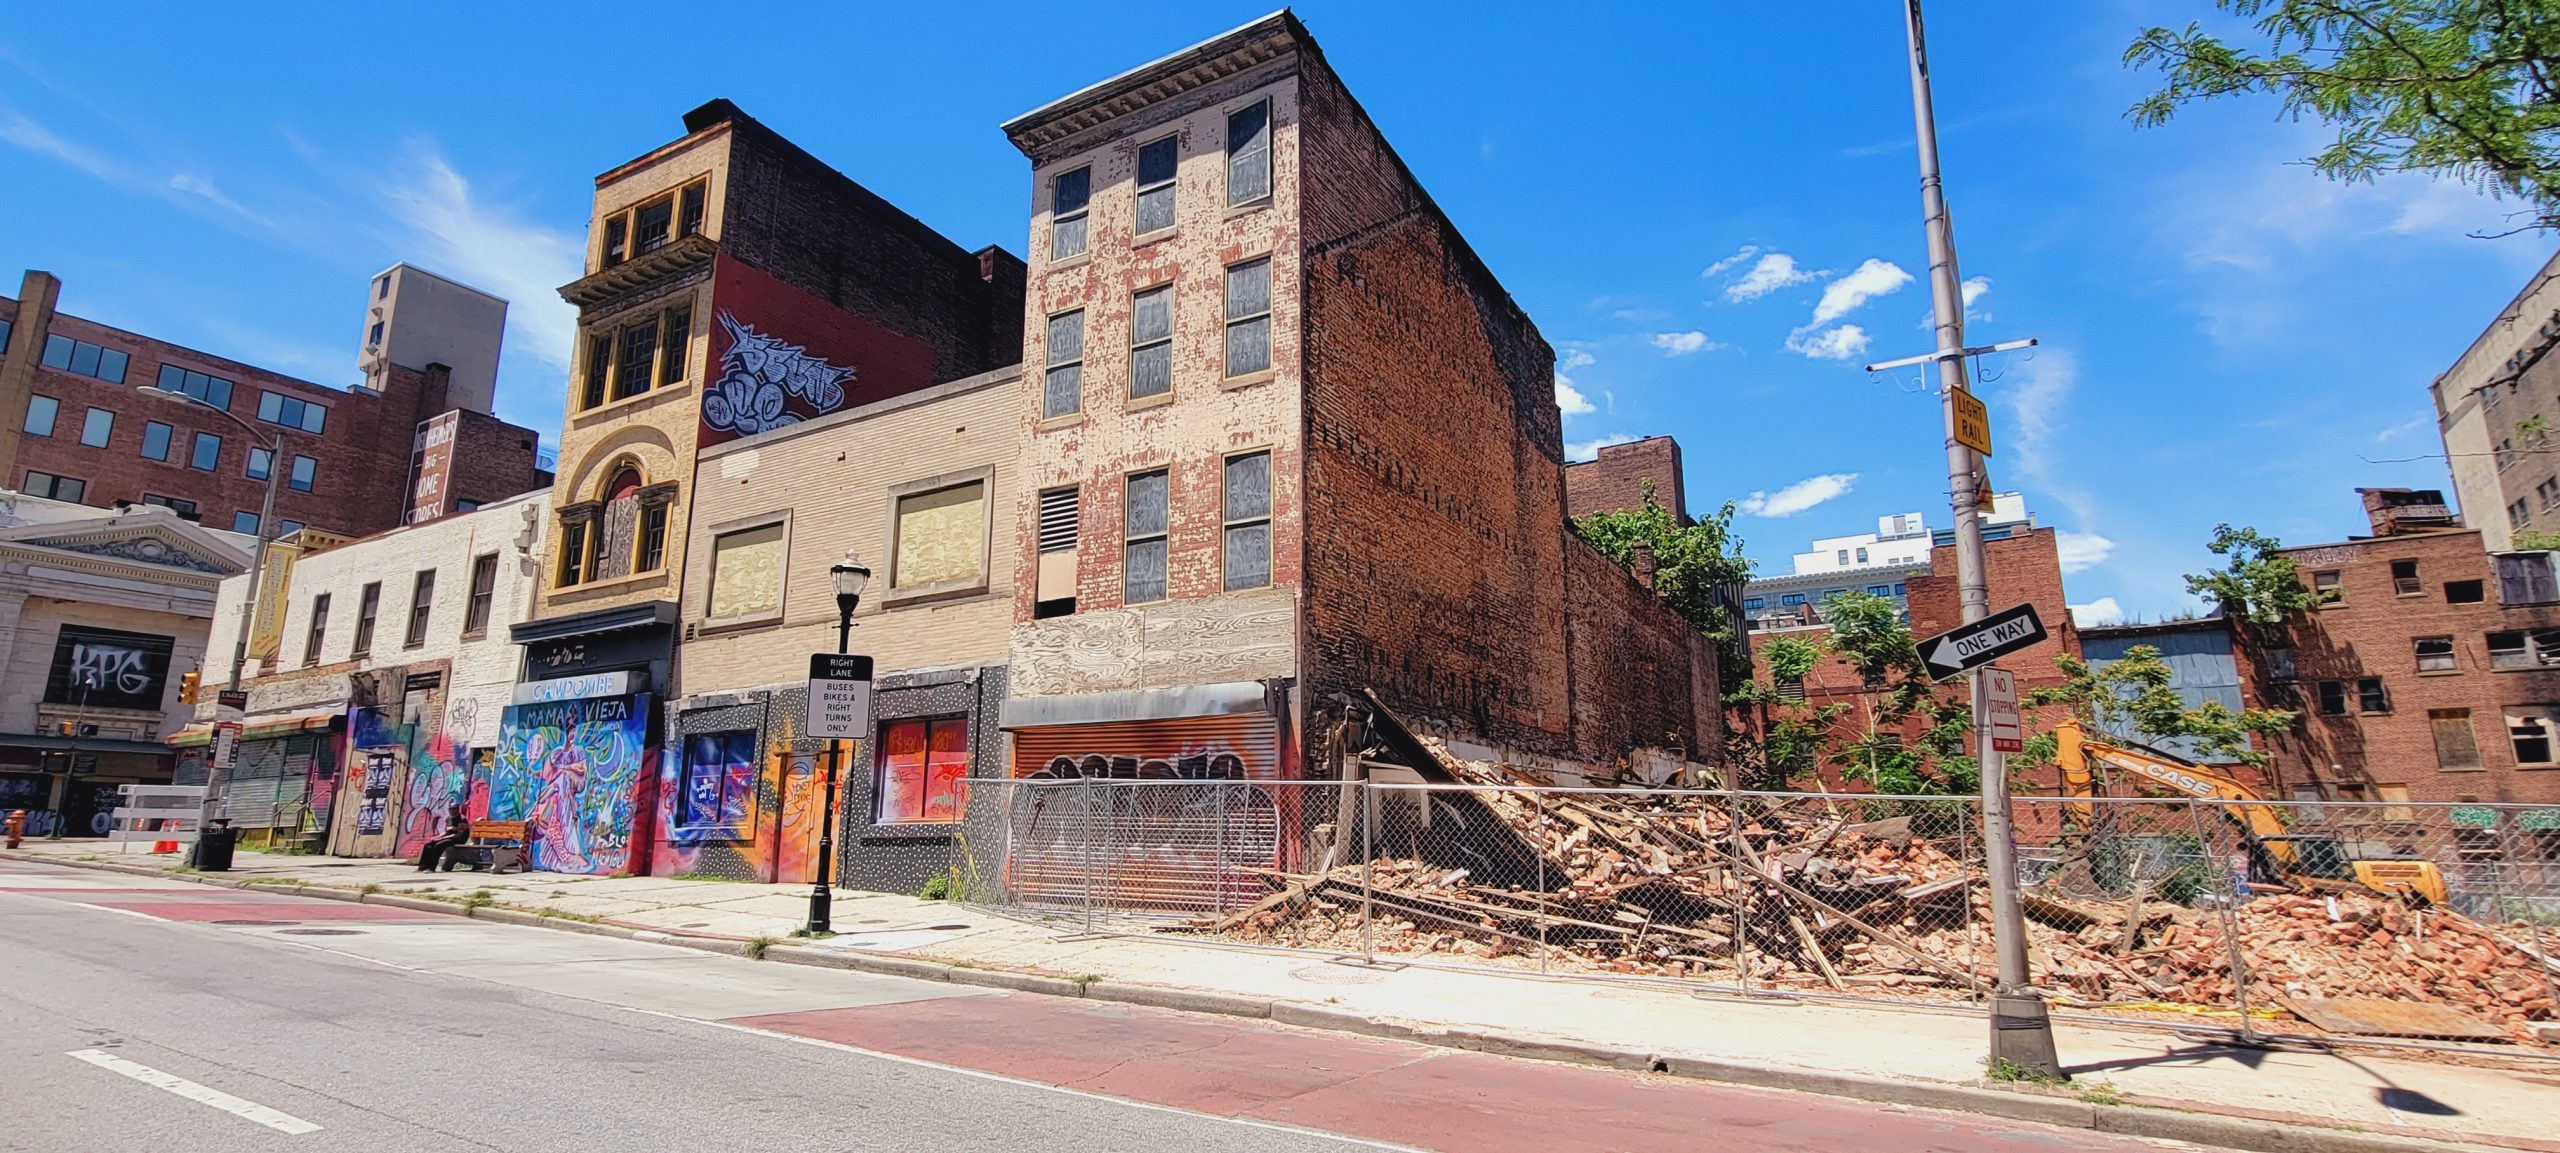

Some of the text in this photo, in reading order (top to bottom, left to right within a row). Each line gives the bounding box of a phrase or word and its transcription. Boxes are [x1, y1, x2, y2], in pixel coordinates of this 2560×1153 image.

[1957, 394, 1983, 423] LIGHT
[1962, 419, 1984, 445] RAIL
[425, 453, 437, 469] BIG
[413, 473, 440, 499] HOME
[1956, 618, 2026, 656] ONE WAY
[830, 659, 854, 667] RIGHT
[830, 669, 853, 677] LANE
[827, 683, 854, 691] BUSES
[1994, 677, 2007, 693] NO
[823, 693, 847, 701] BIKES
[526, 700, 627, 728] MAMA VIEJA
[827, 703, 851, 711] RIGHT
[1990, 699, 2017, 715] STOPPING
[825, 713, 852, 722] TURNS
[827, 724, 848, 732] ONLY
[2146, 763, 2212, 794] CASE
